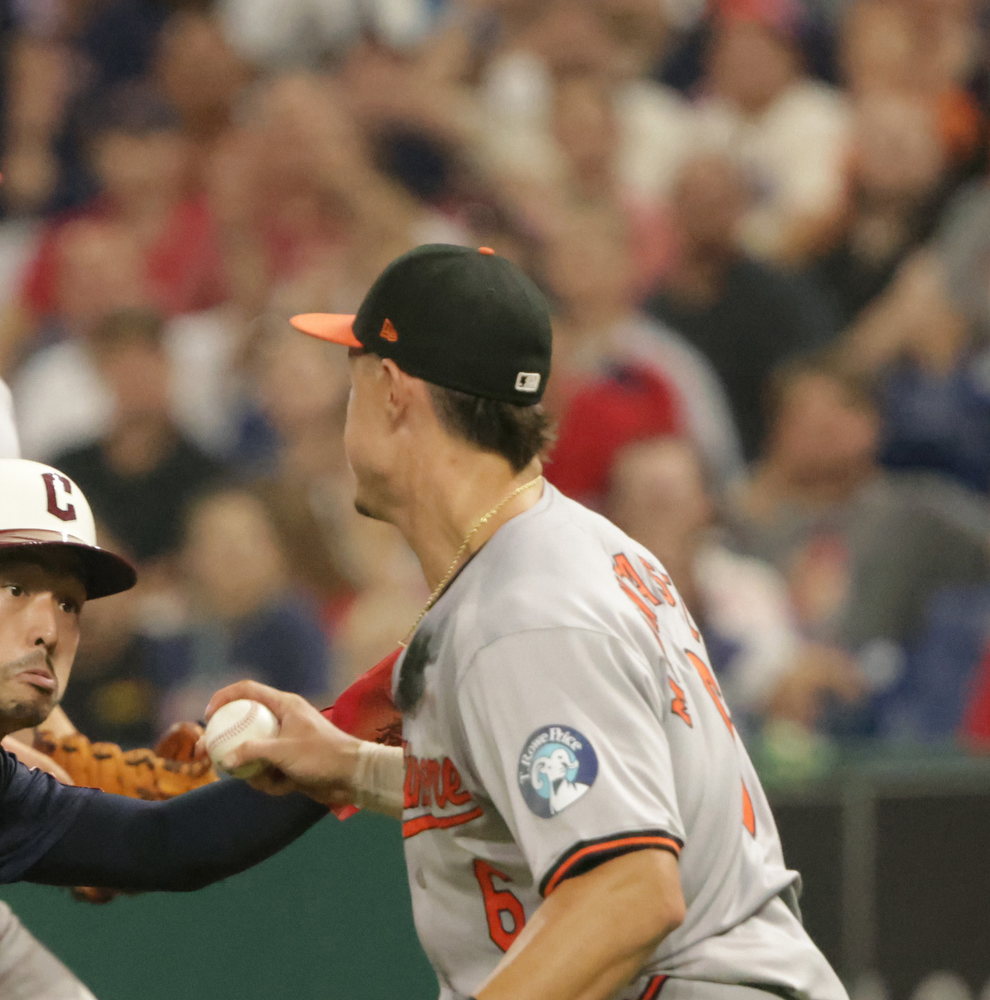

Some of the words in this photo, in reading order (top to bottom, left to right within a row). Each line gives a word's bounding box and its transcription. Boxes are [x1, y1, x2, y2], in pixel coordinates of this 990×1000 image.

[41, 472, 77, 521] C
[549, 726, 583, 752] Price
[473, 857, 527, 954] 6
